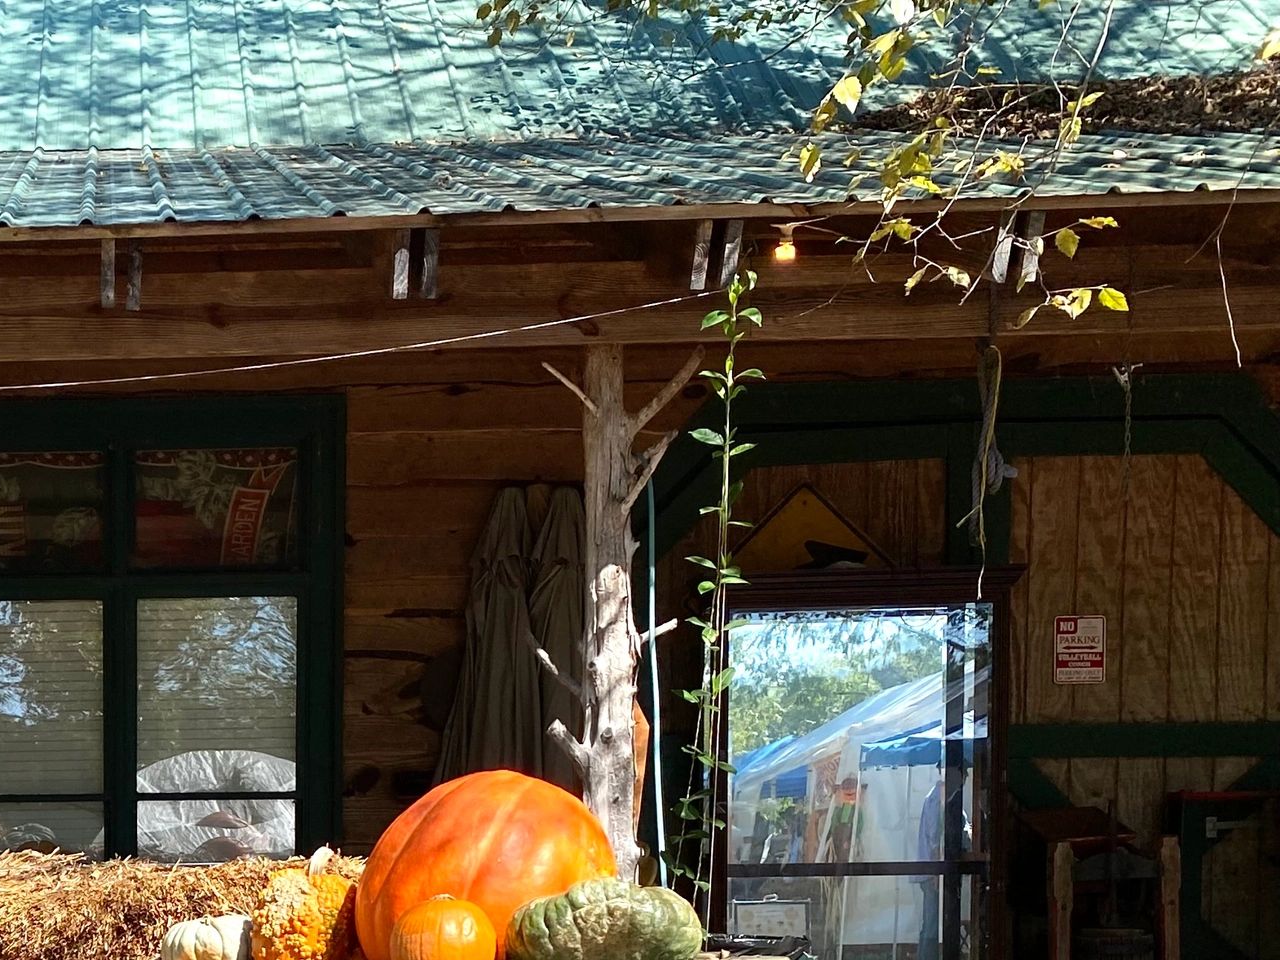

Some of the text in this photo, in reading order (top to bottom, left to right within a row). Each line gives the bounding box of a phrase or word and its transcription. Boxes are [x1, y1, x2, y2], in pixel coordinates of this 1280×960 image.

[1060, 621, 1075, 632] NO
[1059, 635, 1100, 644] PARKING
[1058, 653, 1102, 661] VOLLEYBALL
